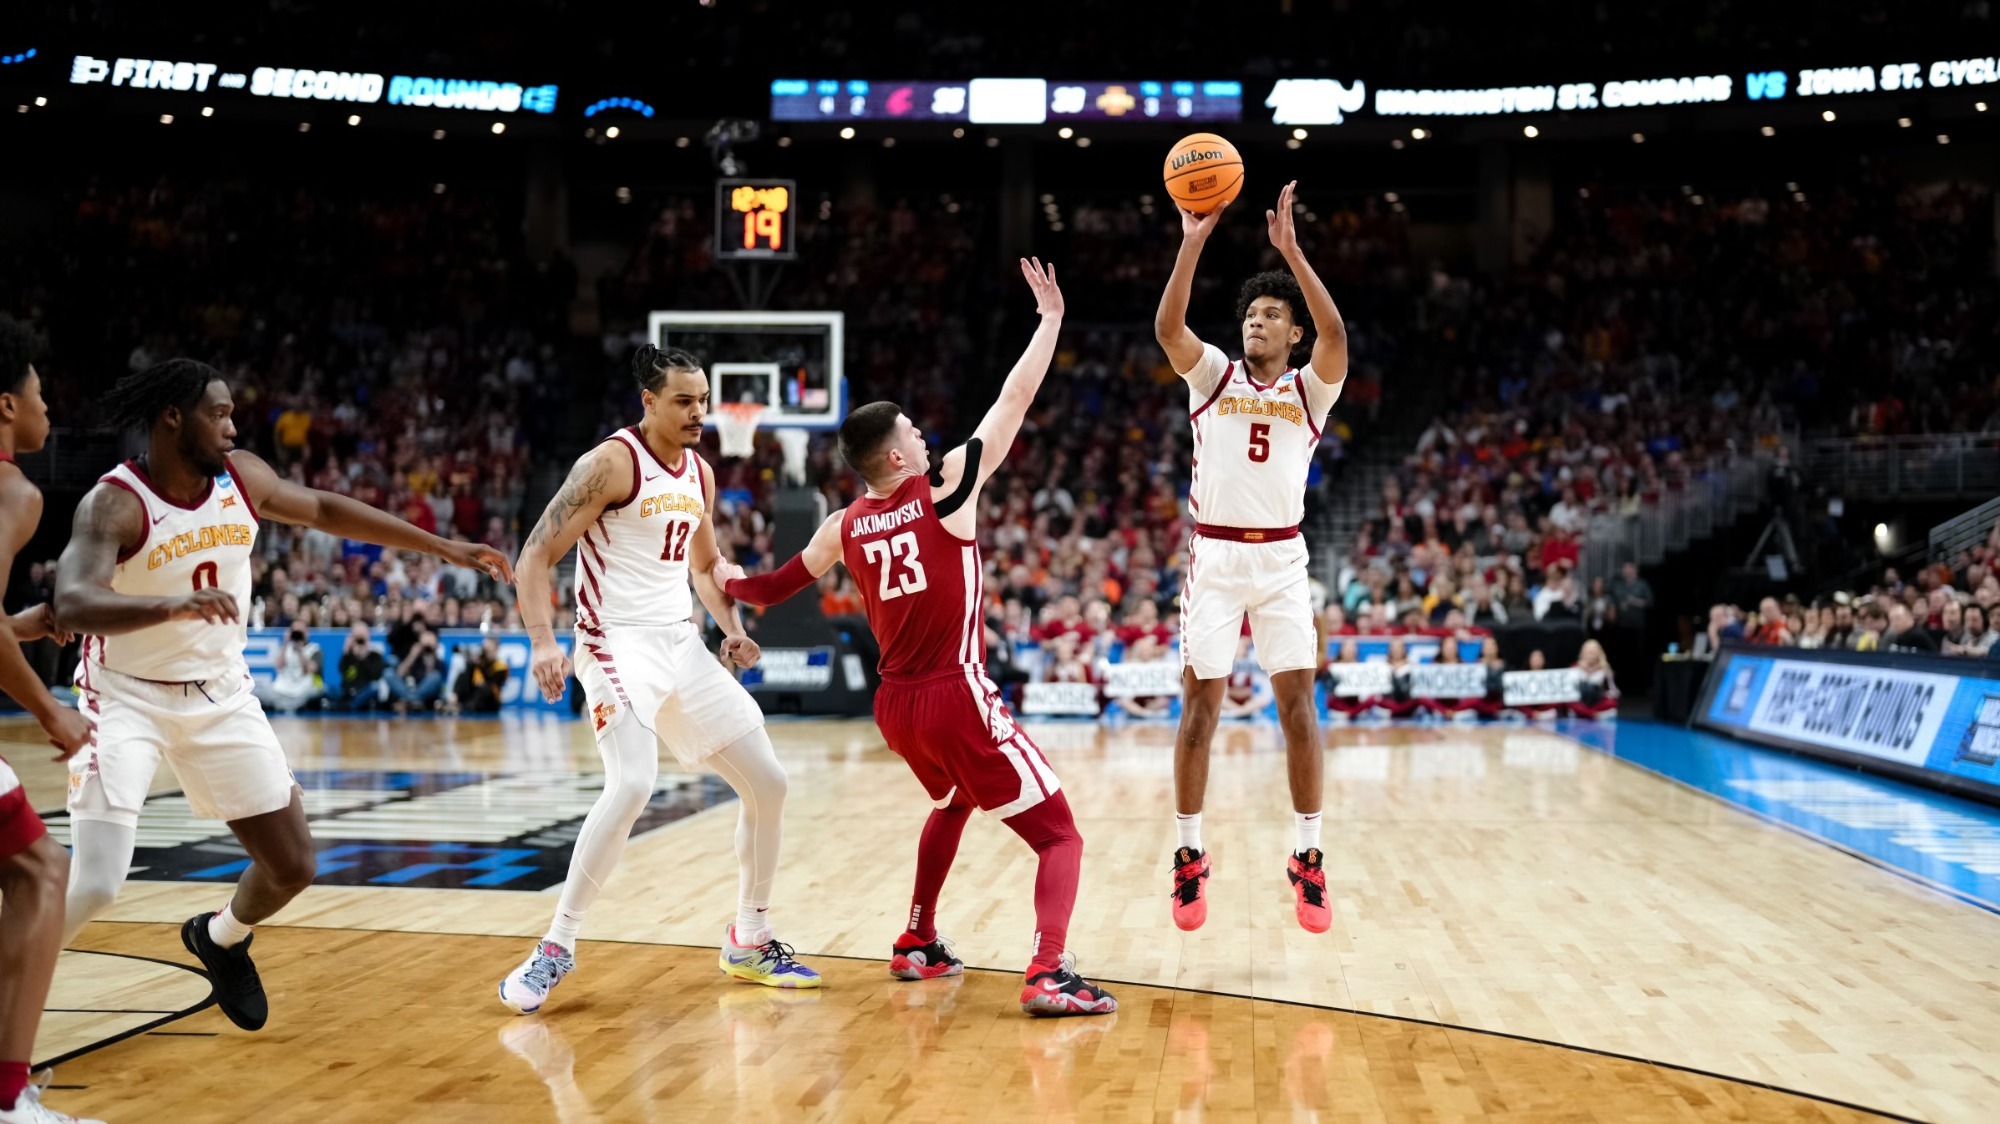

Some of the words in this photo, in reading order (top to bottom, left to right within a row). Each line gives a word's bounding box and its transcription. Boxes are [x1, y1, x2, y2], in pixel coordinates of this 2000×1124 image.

[111, 58, 217, 92] FIRST
[250, 67, 384, 103] SECOND
[388, 75, 523, 112] ROUNDS
[1746, 71, 1787, 100] VS
[1796, 66, 1876, 96] IOWA
[1880, 63, 1923, 90] ST.
[1171, 149, 1223, 170] Wilson
[744, 210, 781, 250] 19
[1218, 397, 1303, 426] CYCLONES
[1248, 423, 1270, 463] 5
[851, 499, 924, 538] JAKIMOVSKI
[147, 524, 251, 570] CYCLONES
[660, 519, 690, 561] 12
[861, 531, 927, 602] 23
[1852, 678, 1936, 751] ROUNDS
